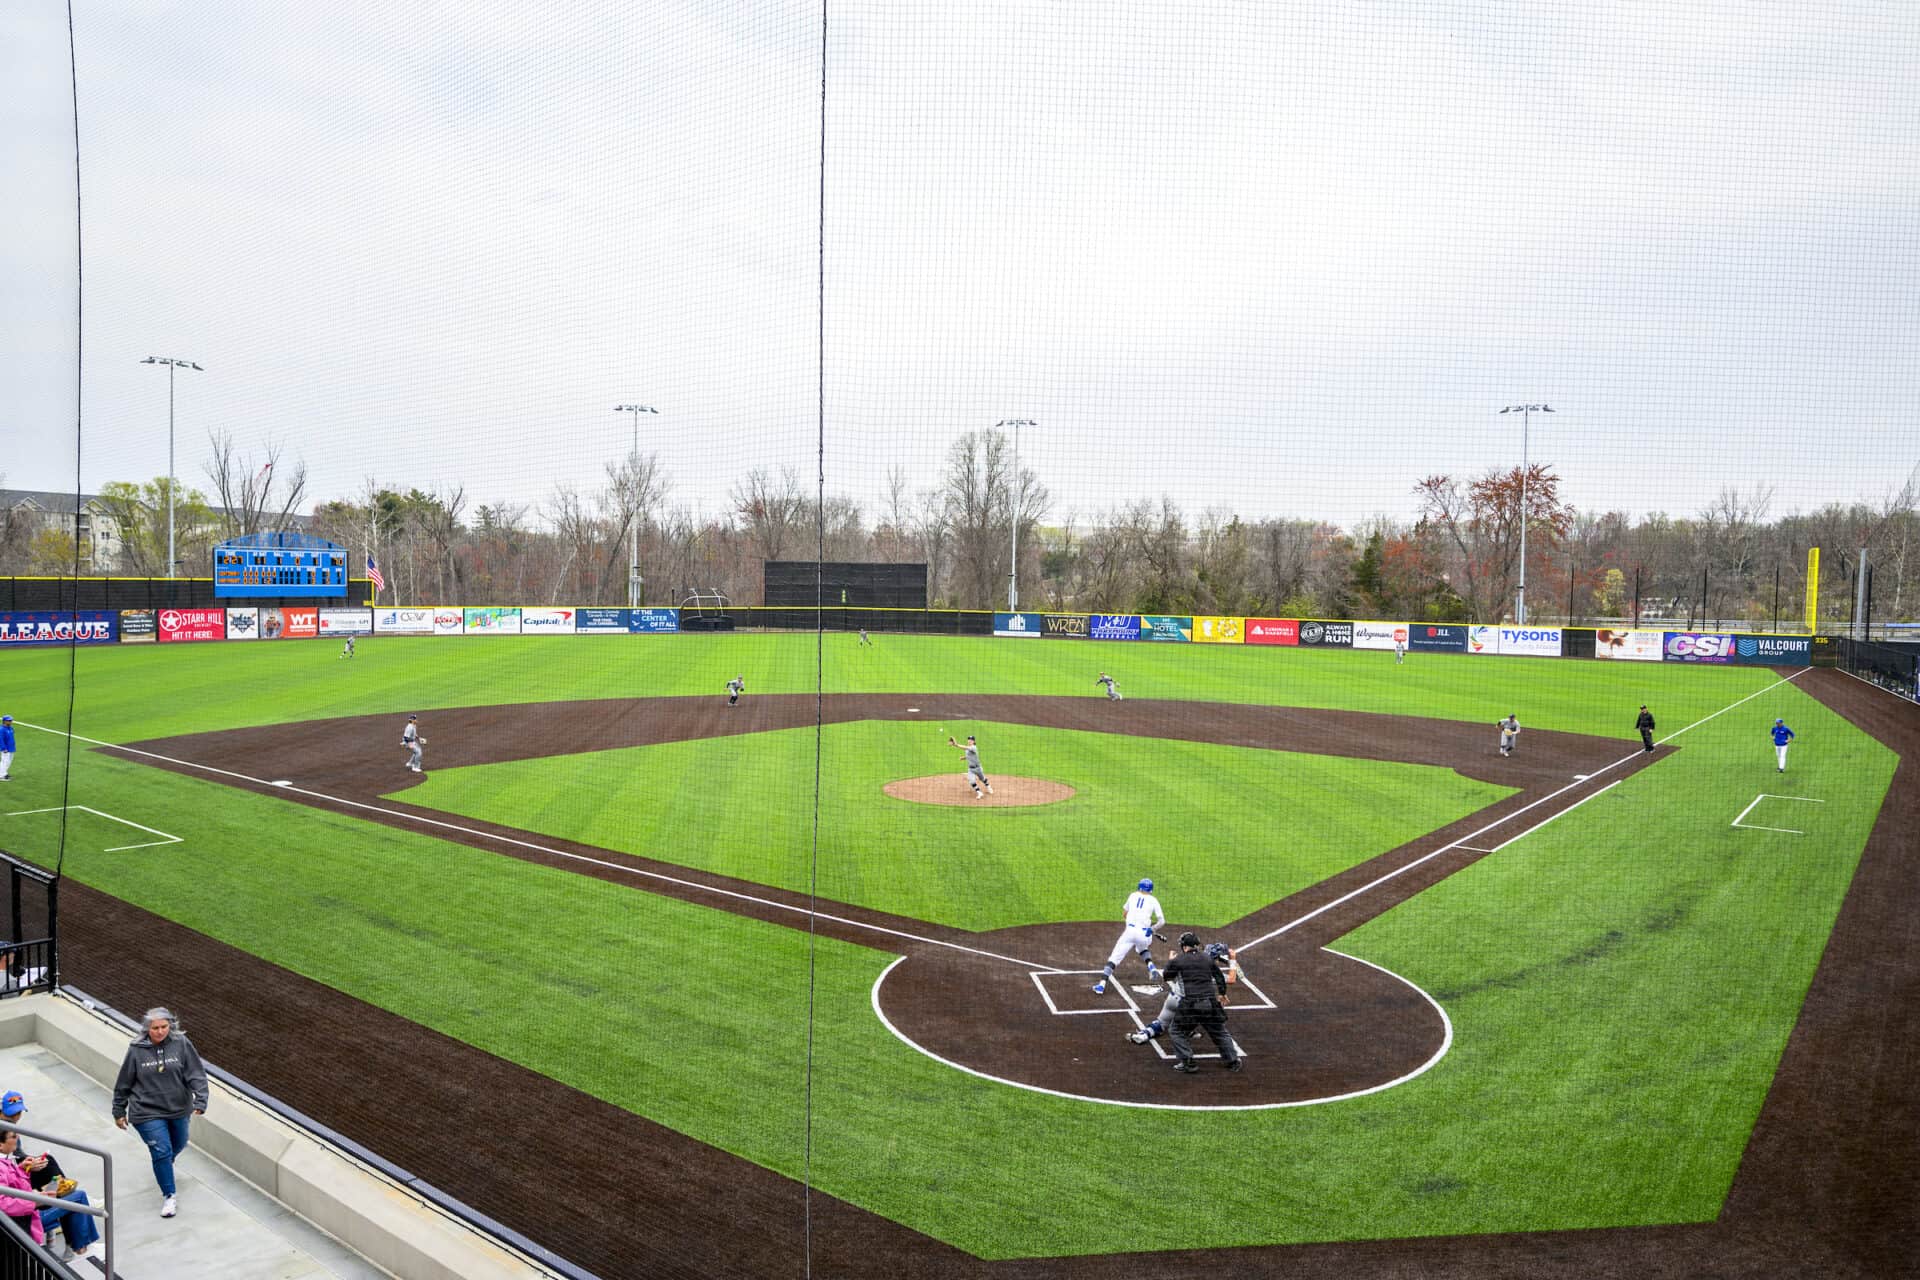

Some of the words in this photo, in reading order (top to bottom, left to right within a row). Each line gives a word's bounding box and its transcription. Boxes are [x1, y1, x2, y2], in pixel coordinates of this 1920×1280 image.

[182, 612, 205, 626] STARR
[207, 612, 223, 625] HILL
[290, 614, 317, 625] WT
[0, 621, 110, 641] LEAGUE
[1325, 635, 1351, 643] RUN
[1758, 639, 1809, 651] VALCOURT
[1668, 636, 1731, 657] CSI
[1136, 897, 1144, 909] 11
